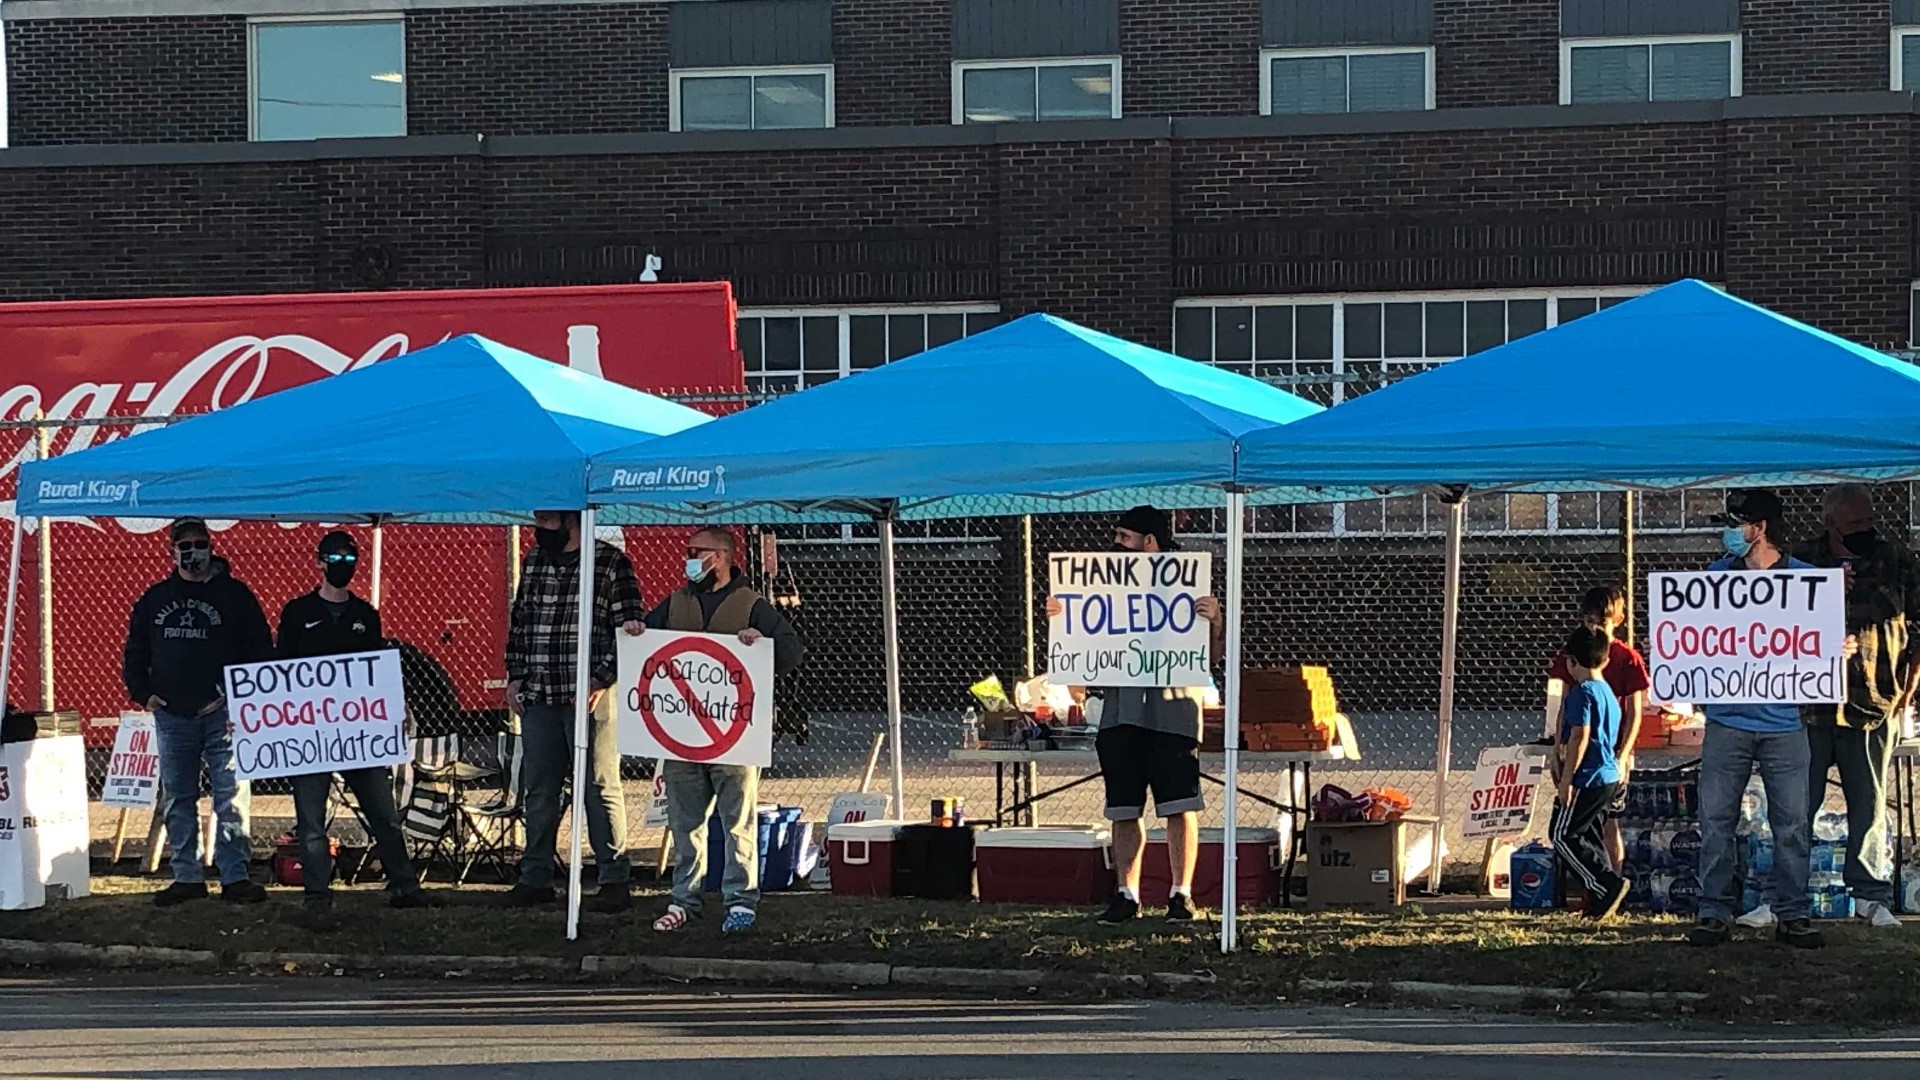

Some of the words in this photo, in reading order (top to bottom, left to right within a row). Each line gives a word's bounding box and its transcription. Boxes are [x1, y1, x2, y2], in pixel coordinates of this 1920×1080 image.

[39, 481, 82, 498] Rural
[88, 480, 127, 500] King
[612, 467, 662, 486] Rural
[667, 466, 710, 488] King
[1051, 556, 1140, 587] THANK
[1148, 555, 1198, 588] YOU
[1661, 573, 1828, 612] BOYCOTT
[1054, 592, 1196, 635] TOLEDO
[1656, 620, 1822, 660] Coca-Cola
[230, 655, 381, 699] BOYCOTT
[1050, 641, 1081, 674] for
[1083, 649, 1126, 682] your
[1128, 638, 1207, 686] Support
[1653, 656, 1845, 701] Consolidated!
[627, 686, 756, 726] Consolidated
[129, 730, 151, 753] ON
[236, 723, 408, 774] Consolidated!
[111, 753, 160, 778] STRIKE
[1494, 763, 1520, 786] ON
[1470, 784, 1534, 811] STRIKE
